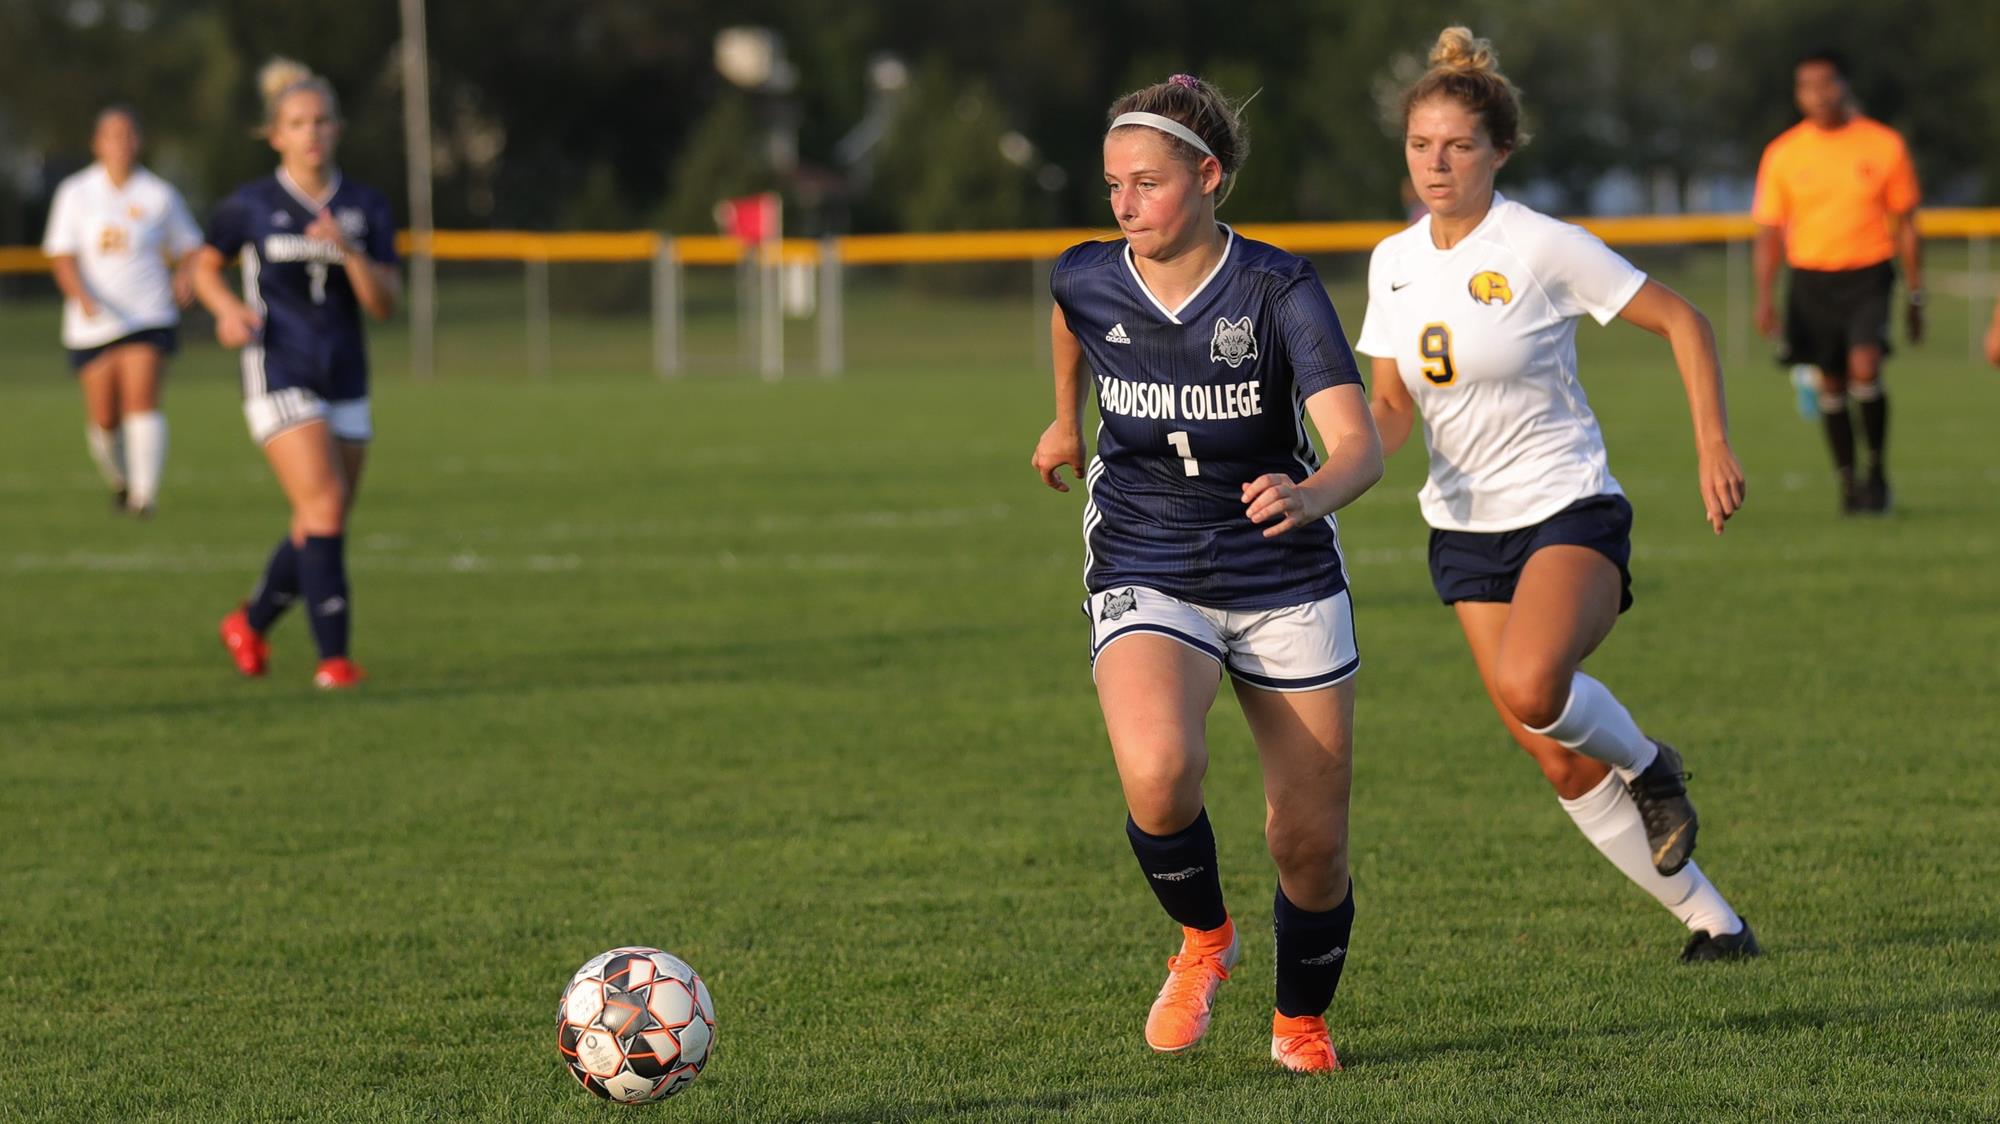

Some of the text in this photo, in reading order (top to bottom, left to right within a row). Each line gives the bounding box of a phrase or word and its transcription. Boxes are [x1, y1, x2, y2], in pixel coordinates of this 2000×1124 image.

[1105, 335, 1131, 345] adidas
[1418, 321, 1457, 387] 9
[1098, 374, 1263, 420] MADISON COLLEGE
[1167, 431, 1199, 477] 1
